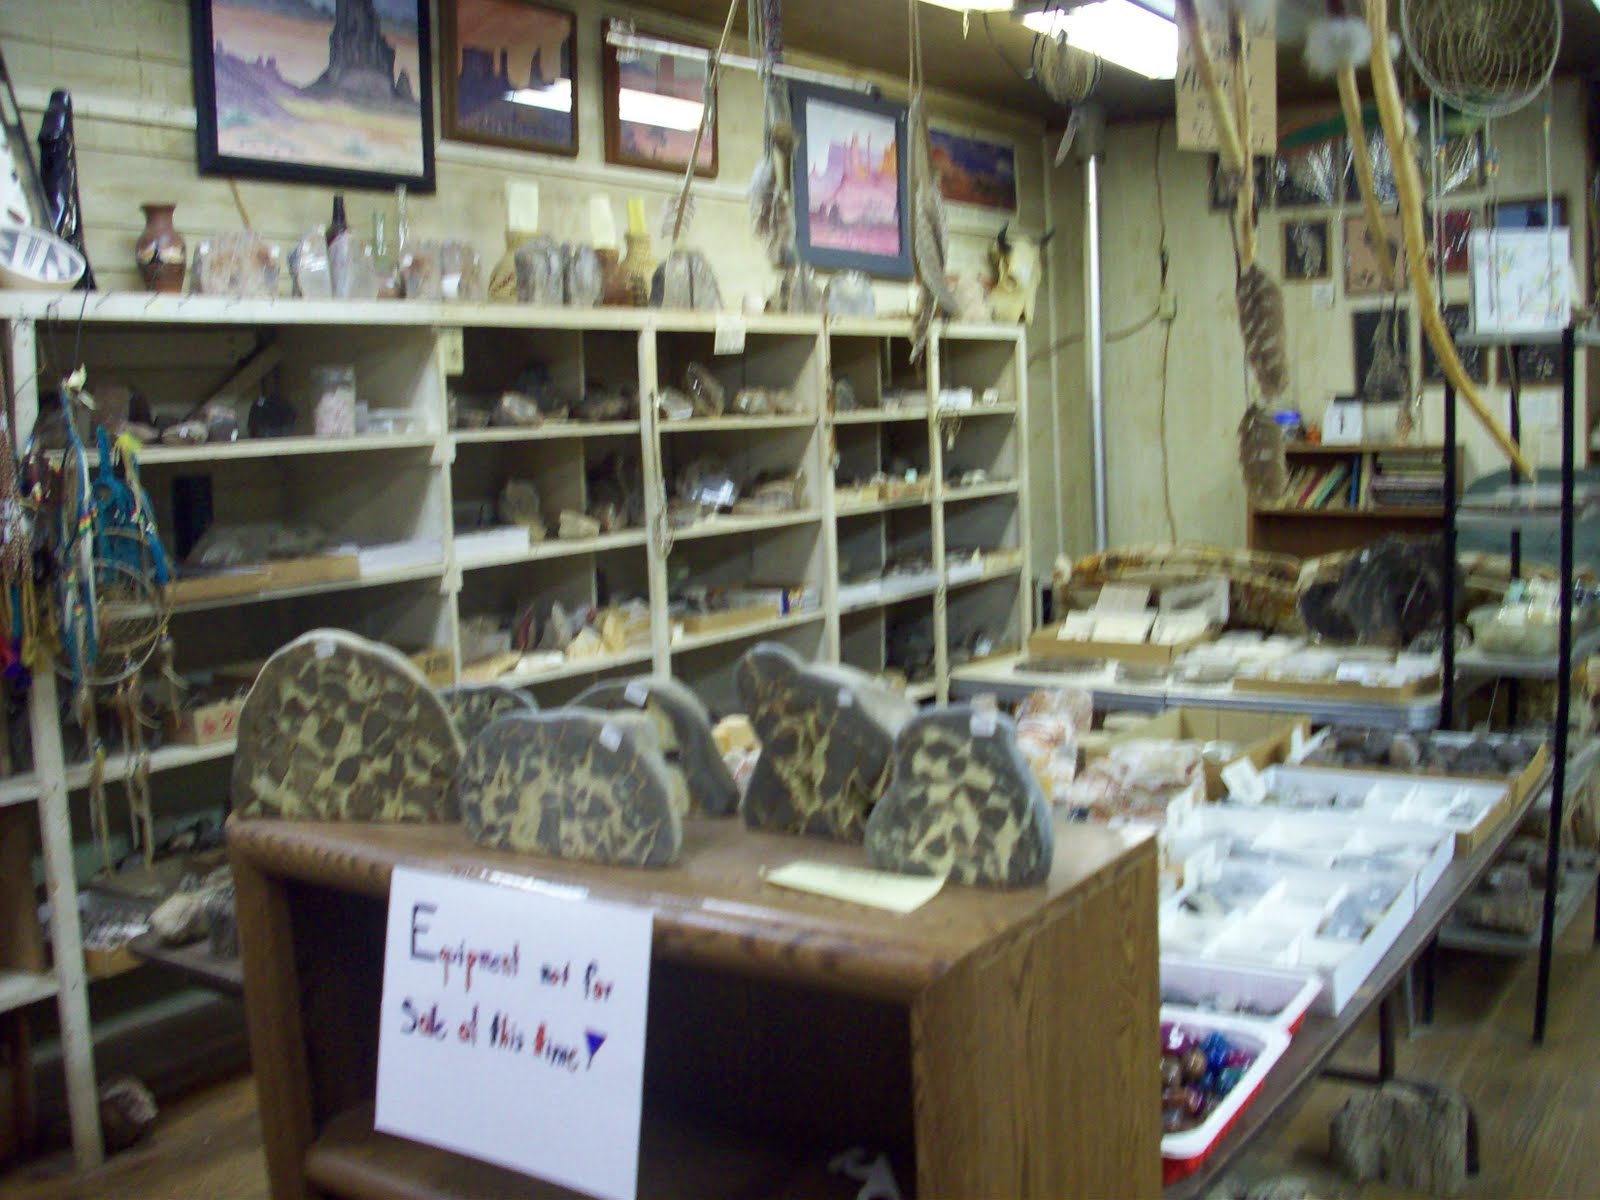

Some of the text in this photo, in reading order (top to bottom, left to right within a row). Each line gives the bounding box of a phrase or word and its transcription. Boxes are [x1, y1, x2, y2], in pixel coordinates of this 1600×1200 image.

[410, 902, 615, 1002] Equipment not for
[400, 996, 448, 1041] Sale
[457, 1001, 480, 1047] at
[489, 1008, 525, 1054] this
